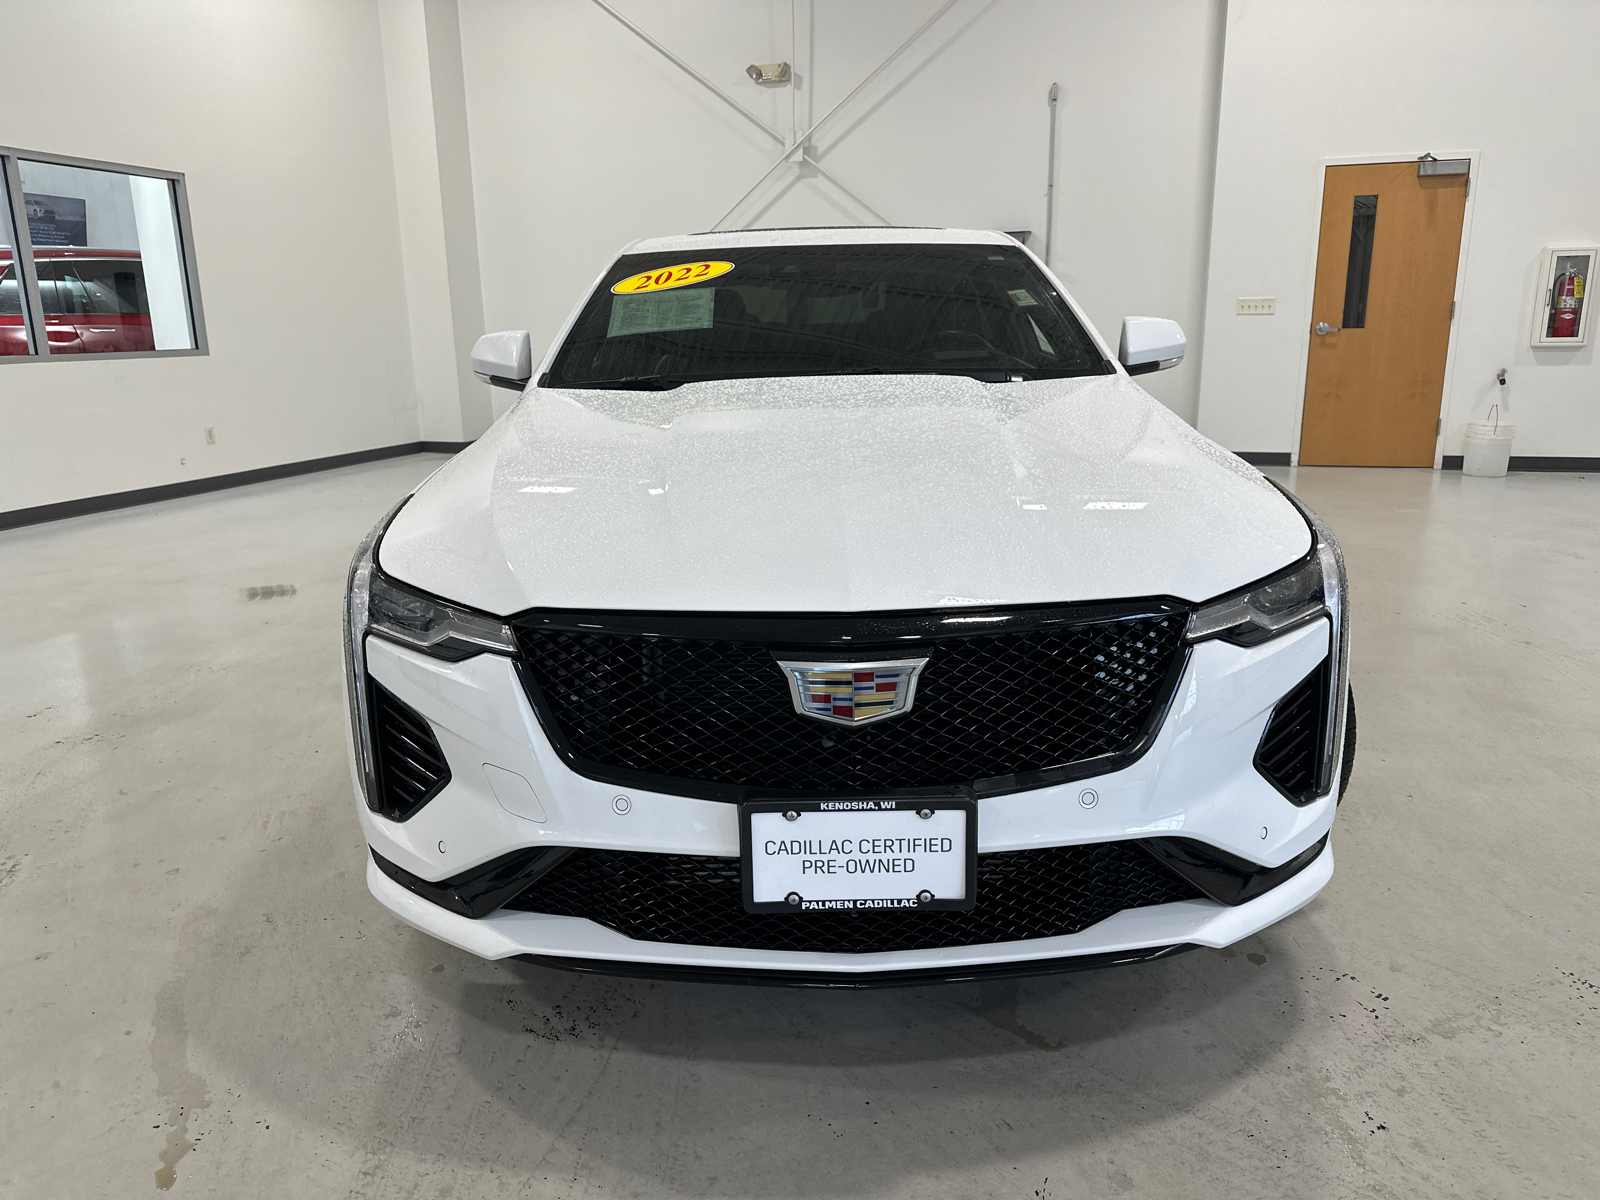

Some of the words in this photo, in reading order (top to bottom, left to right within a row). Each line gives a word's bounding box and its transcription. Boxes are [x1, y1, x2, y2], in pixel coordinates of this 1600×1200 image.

[633, 264, 711, 290] 2022
[820, 801, 878, 811] KENOSHA,
[881, 801, 896, 809] WI
[764, 839, 853, 855] CADILLAC
[858, 838, 952, 854] CERTIFIED
[802, 858, 915, 874] PRE-OWNED
[801, 901, 853, 910] PALMEN
[857, 899, 918, 909] CADILLAC
